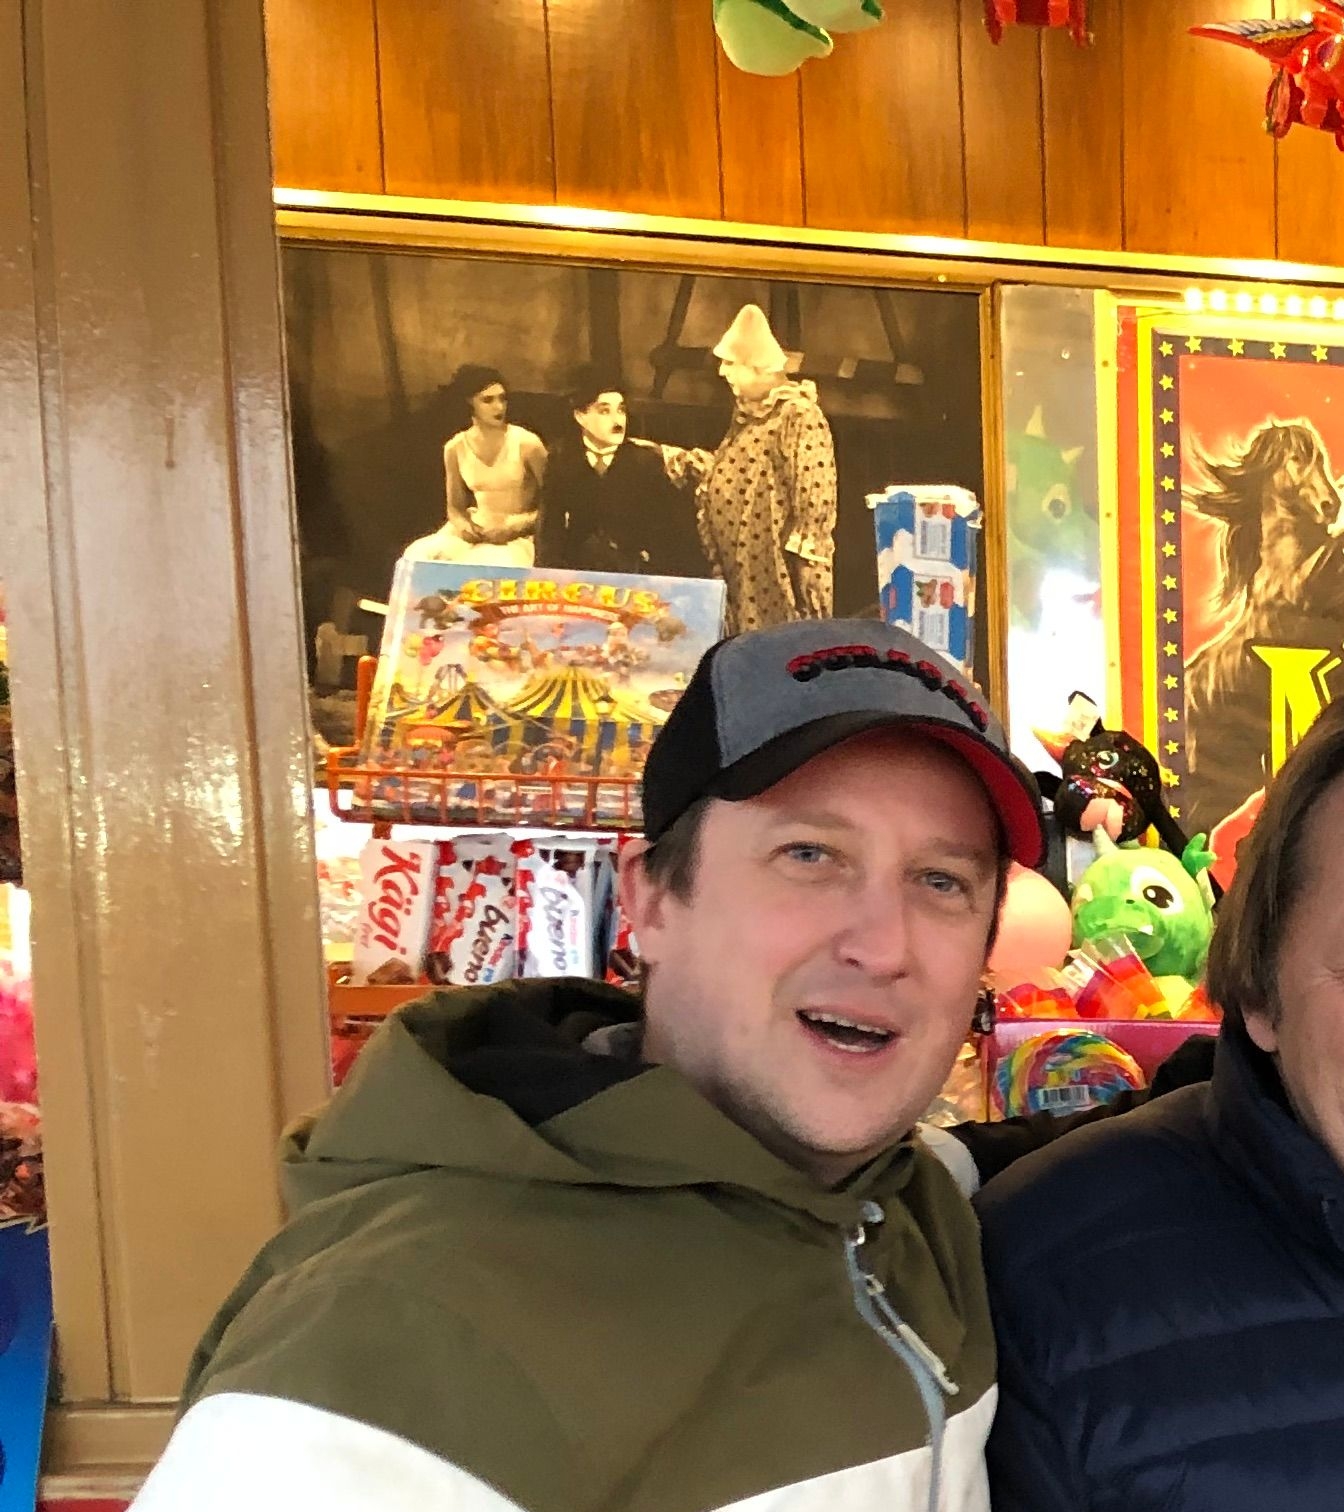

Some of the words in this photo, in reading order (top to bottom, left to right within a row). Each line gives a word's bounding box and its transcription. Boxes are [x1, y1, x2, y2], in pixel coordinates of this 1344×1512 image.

[459, 578, 662, 615] CIRCUS
[368, 846, 421, 956] Kägi
[540, 886, 568, 971] bueno
[464, 904, 510, 983] bueno
